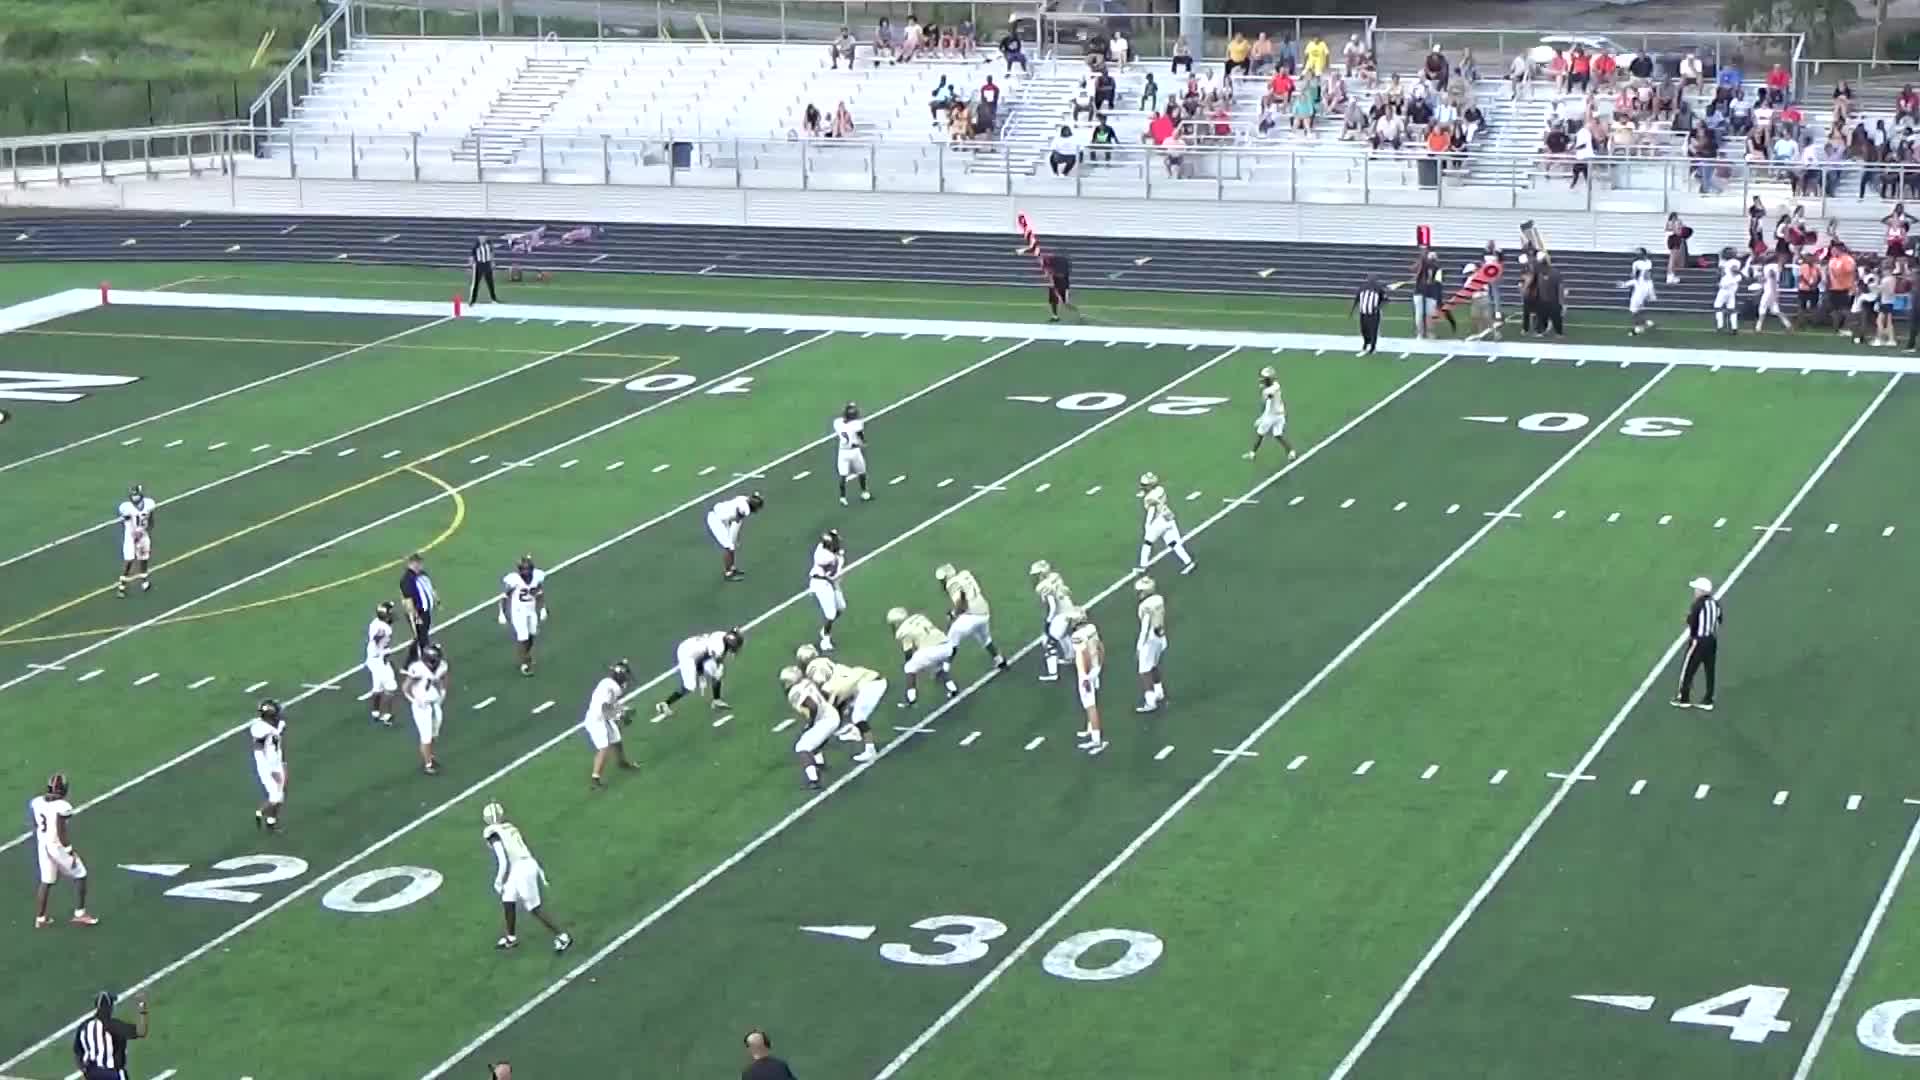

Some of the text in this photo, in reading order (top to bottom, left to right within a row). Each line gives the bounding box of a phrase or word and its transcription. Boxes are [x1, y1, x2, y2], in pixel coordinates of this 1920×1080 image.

[1054, 391, 1231, 415] 20
[1517, 412, 1694, 437] 30
[40, 814, 48, 833] 3
[162, 854, 444, 914] 20
[878, 915, 1165, 982] 30
